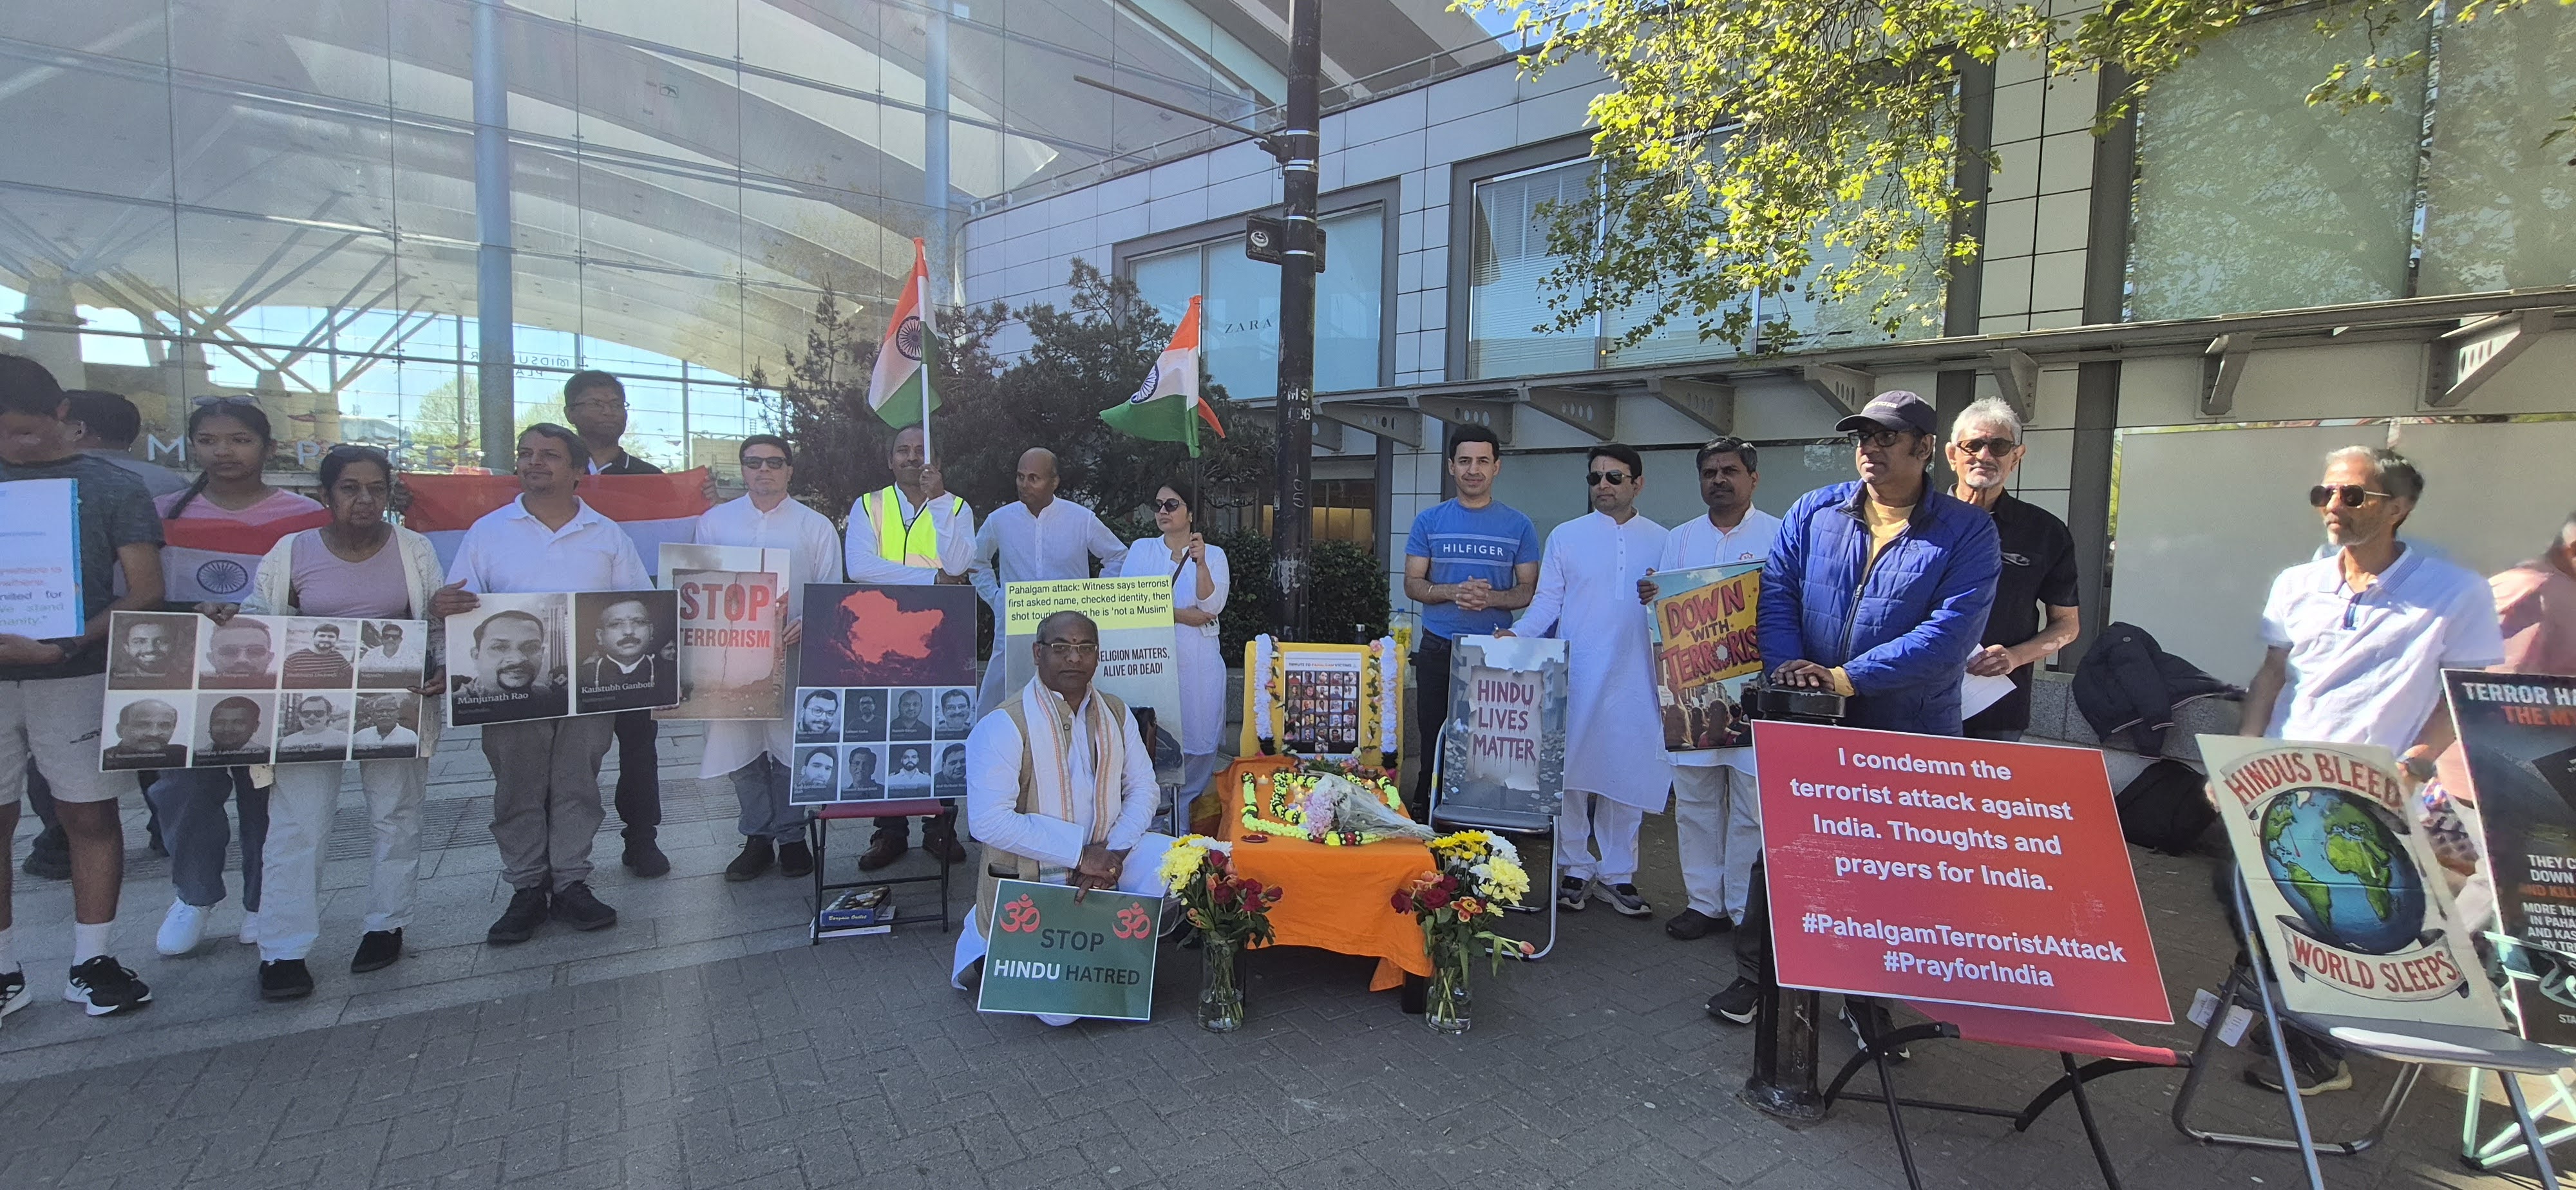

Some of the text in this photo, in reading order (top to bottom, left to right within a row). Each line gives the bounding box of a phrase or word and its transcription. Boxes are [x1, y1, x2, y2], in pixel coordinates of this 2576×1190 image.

[1225, 318, 1272, 334] ZARA
[1443, 542, 1504, 557] HILFIGER
[1009, 580, 1170, 595] Pahalgam attack: Witness says terrorist
[680, 581, 770, 621] STOP
[1009, 592, 1171, 607] first asked name, checked identity, then
[1665, 580, 1745, 639] DOWN
[1011, 611, 1030, 621] shot
[1032, 610, 1057, 619] touri
[1090, 608, 1100, 616] he
[1103, 607, 1110, 616] is
[1112, 607, 1128, 616] 'not
[1137, 605, 1168, 614] Muslim'
[1690, 618, 1730, 643] WITH
[1098, 647, 1170, 662] ELIGION MATTERS,
[1659, 625, 1761, 688] TERRORIS
[1103, 662, 1163, 677] ALIVE OR DEAD!
[458, 694, 509, 705] Manjunath
[581, 683, 620, 694] Kaustubh
[1477, 679, 1534, 707] HINDU
[2461, 683, 2550, 704] TERROR
[1478, 707, 1529, 733] LIVES
[2501, 705, 2547, 725] THE
[1473, 733, 1537, 765] MATTER
[1838, 748, 2012, 780] I condemn the
[2223, 753, 2403, 808] HINDUS BLEED
[1790, 778, 2074, 820] terrorist attack against
[1813, 813, 2062, 855] India. Thoughts and
[2526, 854, 2562, 869] THEY
[1835, 856, 2054, 891] prayers for India.
[2530, 869, 2575, 883] DOWN
[2523, 902, 2576, 917] MORE TH
[2530, 914, 2543, 925] IN
[1040, 928, 1104, 952] STOP
[1802, 912, 2127, 963] #PahalgamTerroristAttack
[2528, 926, 2553, 938] AND
[2541, 940, 2557, 950] BY
[994, 959, 1141, 986] HINDU HATRED
[1883, 950, 2054, 987] #PrayforIndia
[2293, 936, 2375, 990] WORLD
